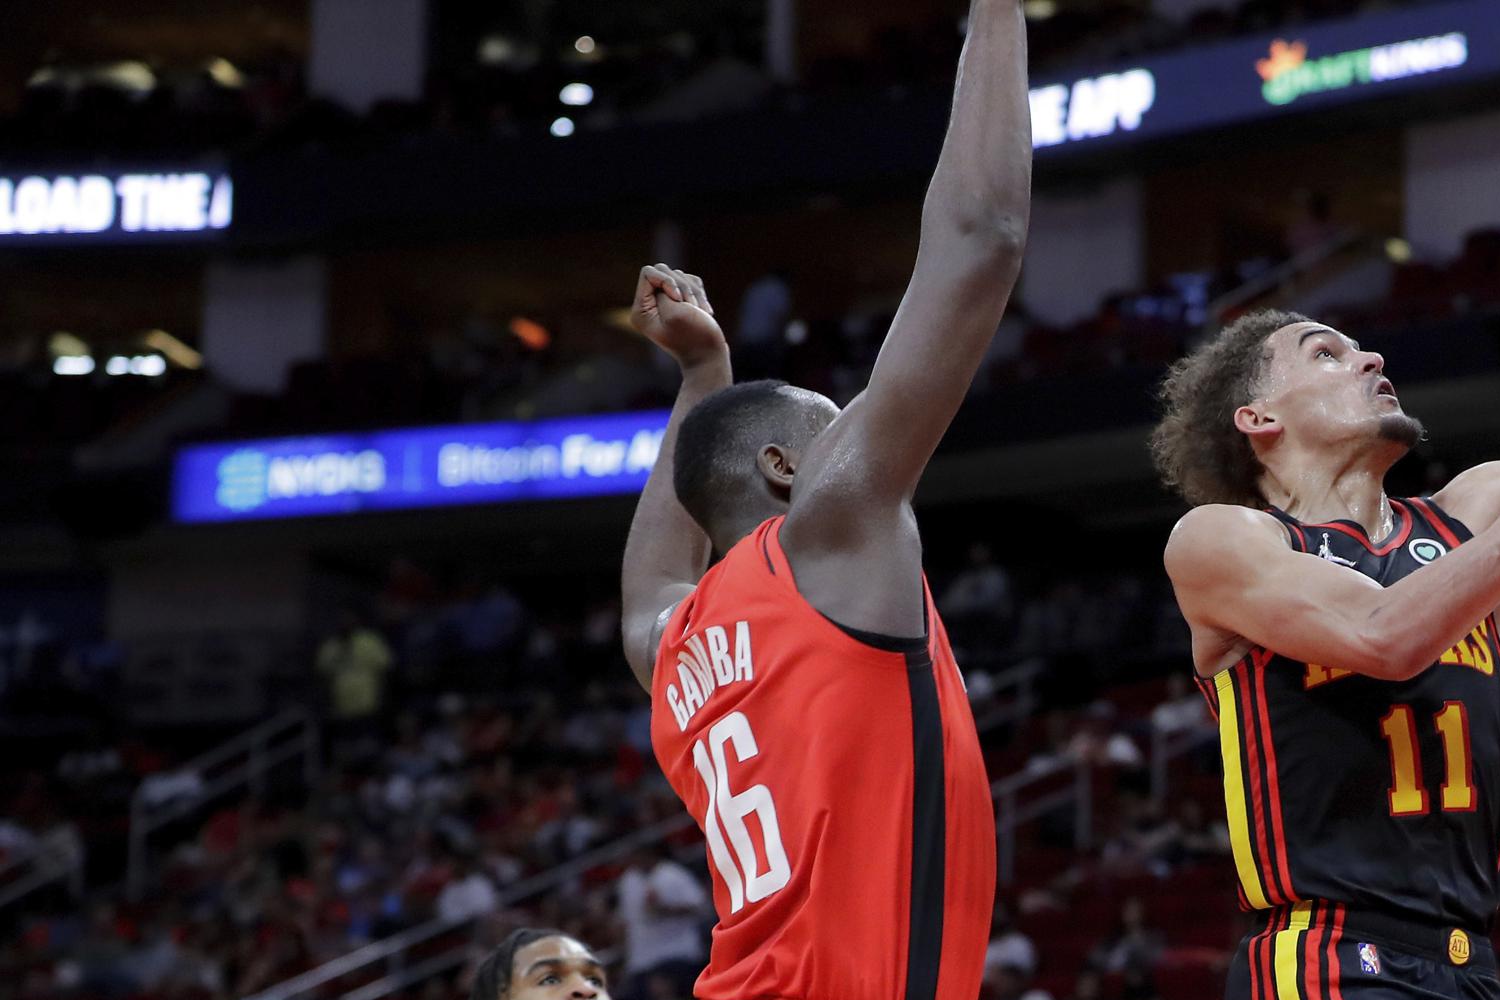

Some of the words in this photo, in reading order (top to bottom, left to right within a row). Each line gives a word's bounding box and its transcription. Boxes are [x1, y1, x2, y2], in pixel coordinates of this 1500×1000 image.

[1067, 68, 1157, 142] APP
[116, 172, 212, 233] THE
[560, 433, 630, 479] For
[1379, 700, 1477, 816] 11
[693, 711, 791, 914] 16
[1451, 938, 1468, 955] ATL
